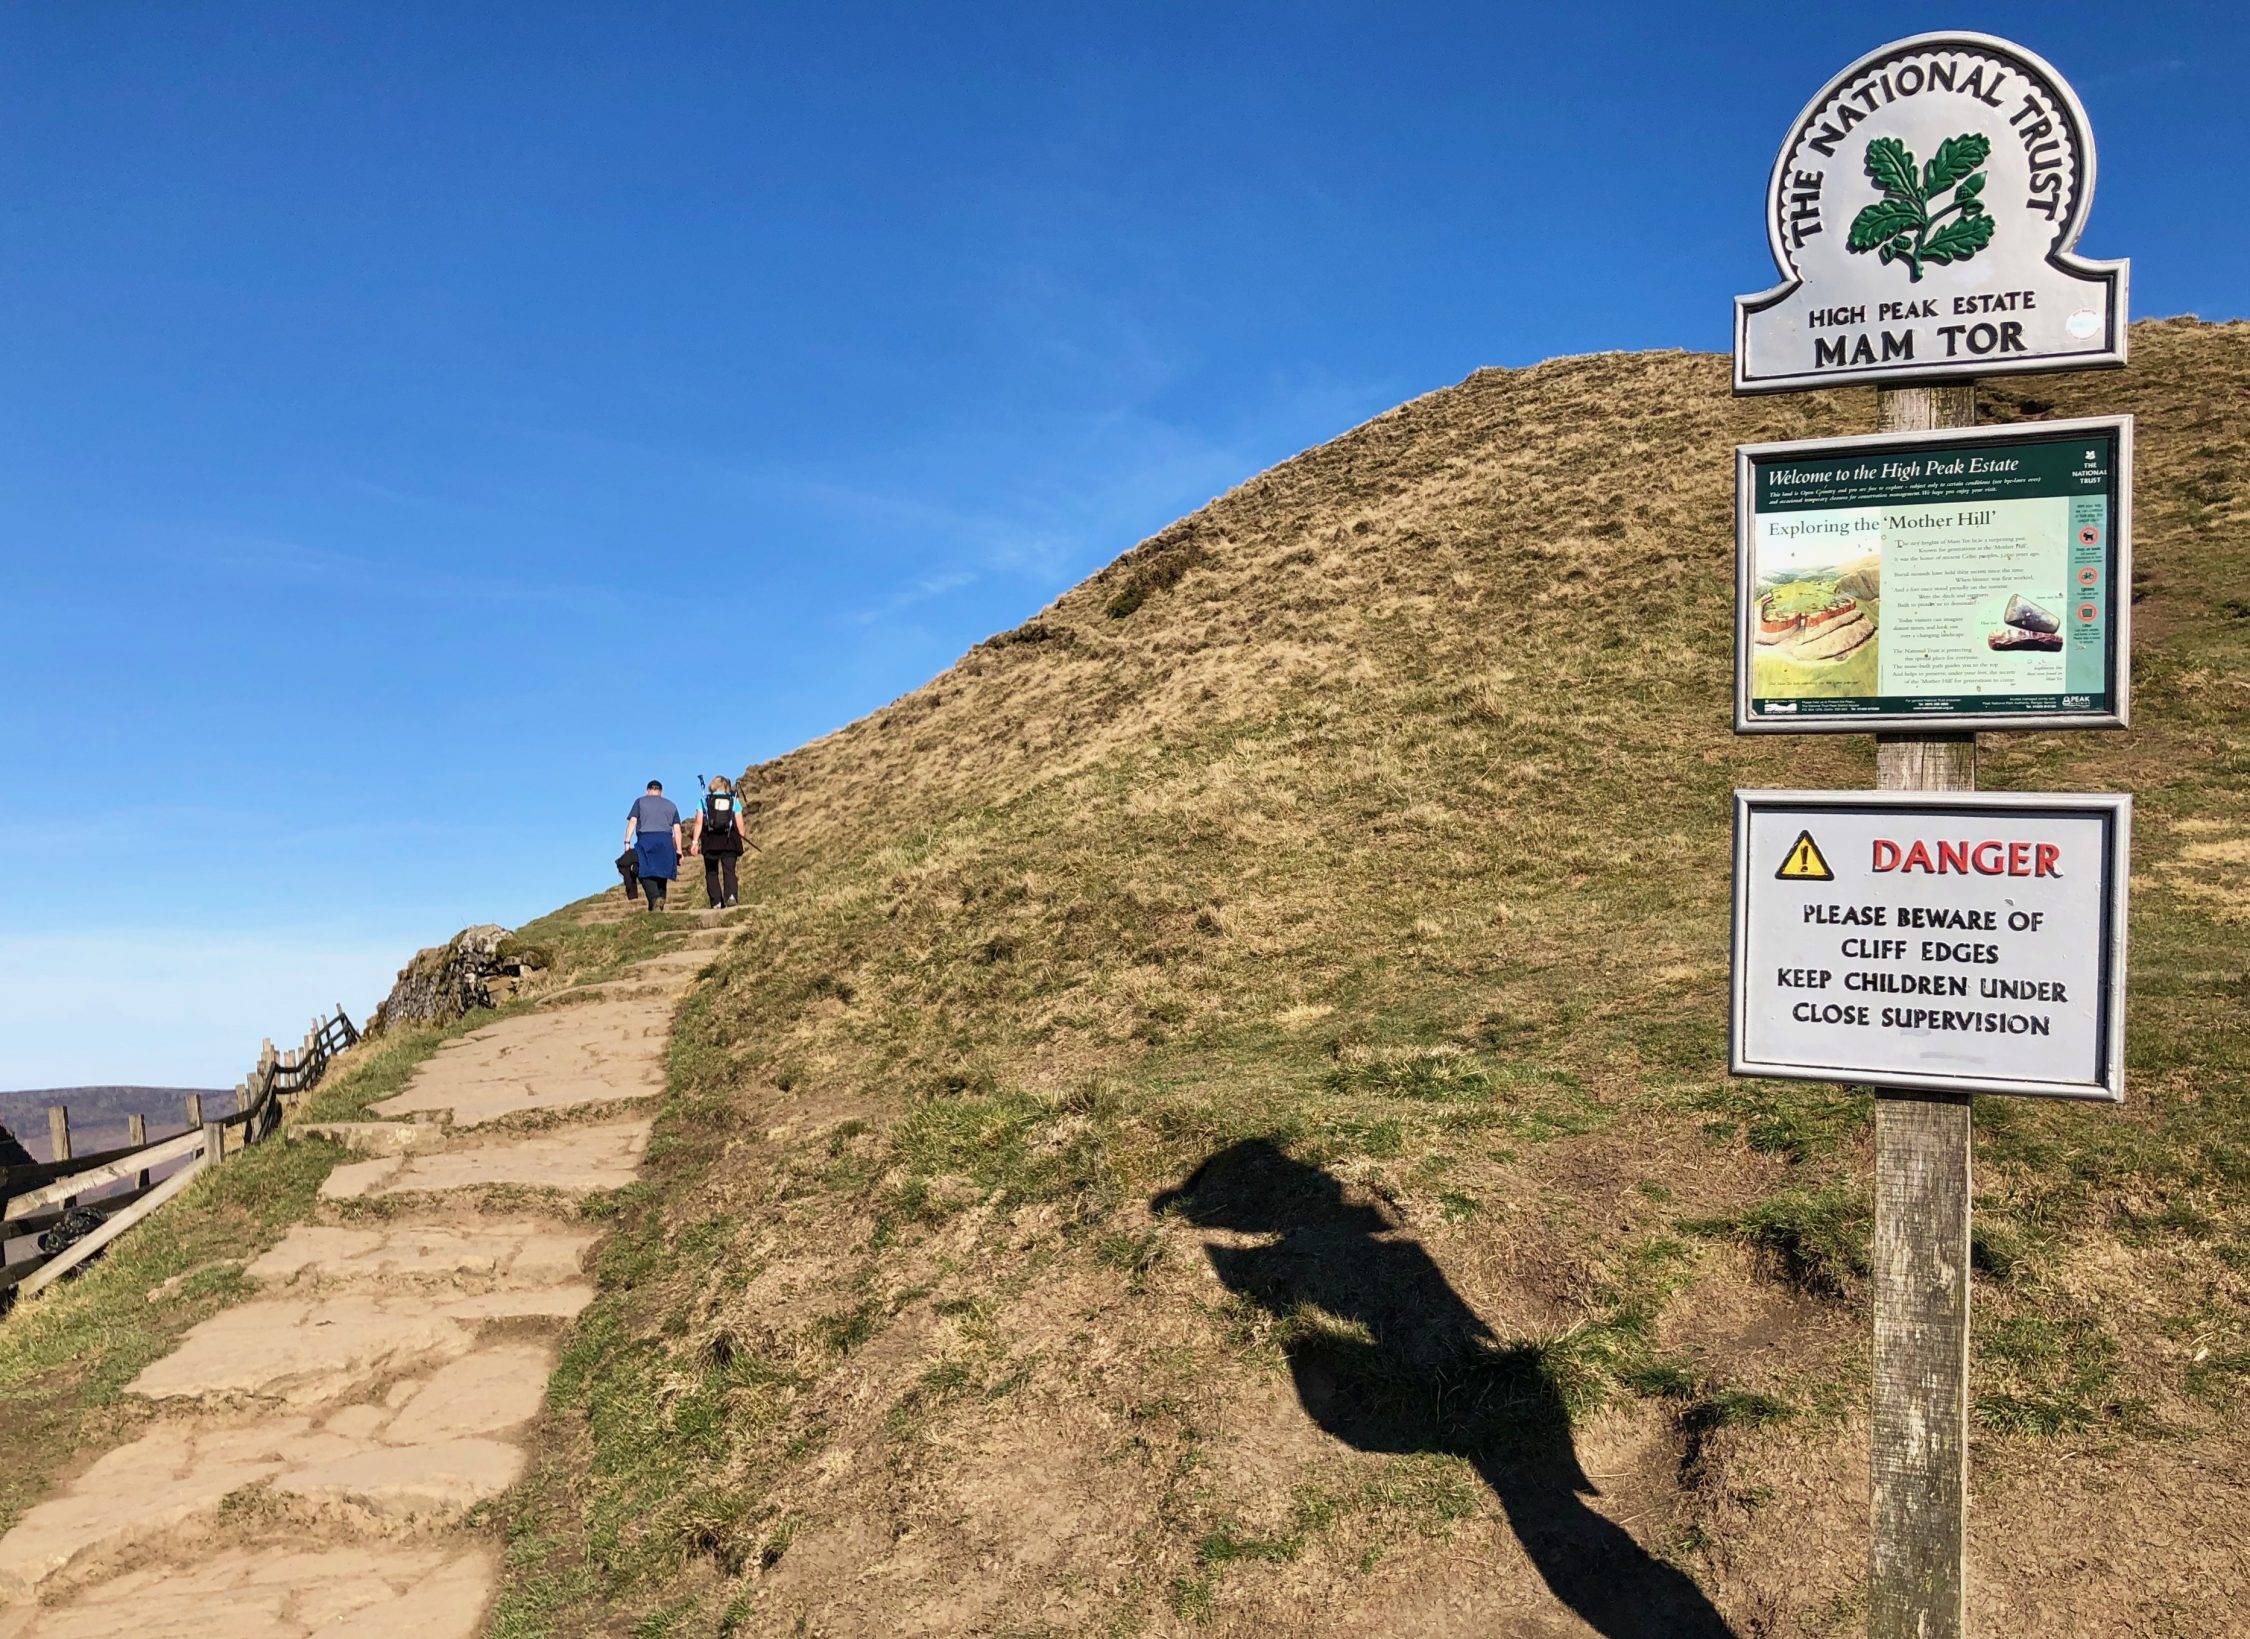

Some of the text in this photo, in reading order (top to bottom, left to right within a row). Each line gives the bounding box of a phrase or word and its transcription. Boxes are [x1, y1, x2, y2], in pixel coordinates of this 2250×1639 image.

[1791, 61, 2063, 248] THE NATIONAL TRUST
[1809, 291, 2036, 328] HIGH PEAK ESTATE
[1814, 321, 2028, 368] MAM TOR
[1769, 457, 2019, 486] Welcome to the High Peak Estate
[1769, 510, 1996, 539] Exploring the 'Mother Hill'
[1871, 839, 2064, 879] DANGER
[1803, 904, 2043, 932] PLEASE BEWARE OF
[1841, 938, 1999, 964] CLIFF EDGES
[1777, 968, 2068, 1003] KEEP CHILDREN UNDER
[1792, 1002, 2051, 1036] CLOSE SUPERVISION
